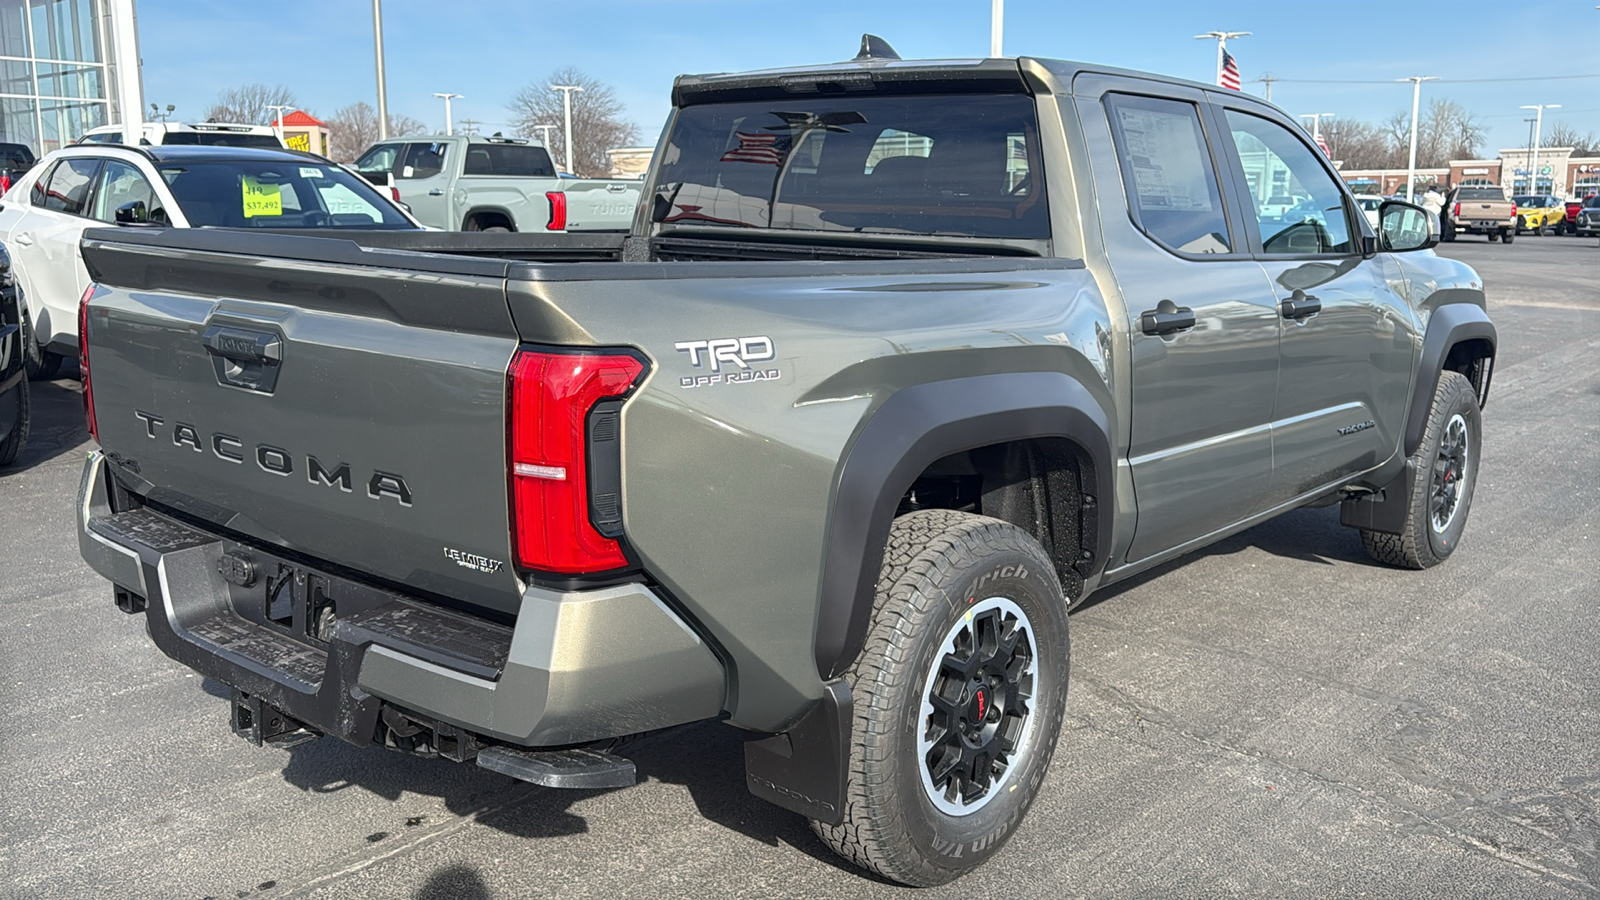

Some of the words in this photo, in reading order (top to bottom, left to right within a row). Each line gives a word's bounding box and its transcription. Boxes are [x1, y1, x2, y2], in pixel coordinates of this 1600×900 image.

[246, 201, 279, 210] $37,492
[589, 203, 635, 215] TUNDR
[219, 336, 256, 355] TOYOTA
[674, 335, 777, 373] TRD
[680, 375, 721, 389] OFF
[725, 368, 781, 385] ROAD
[134, 408, 413, 507] TACOMA
